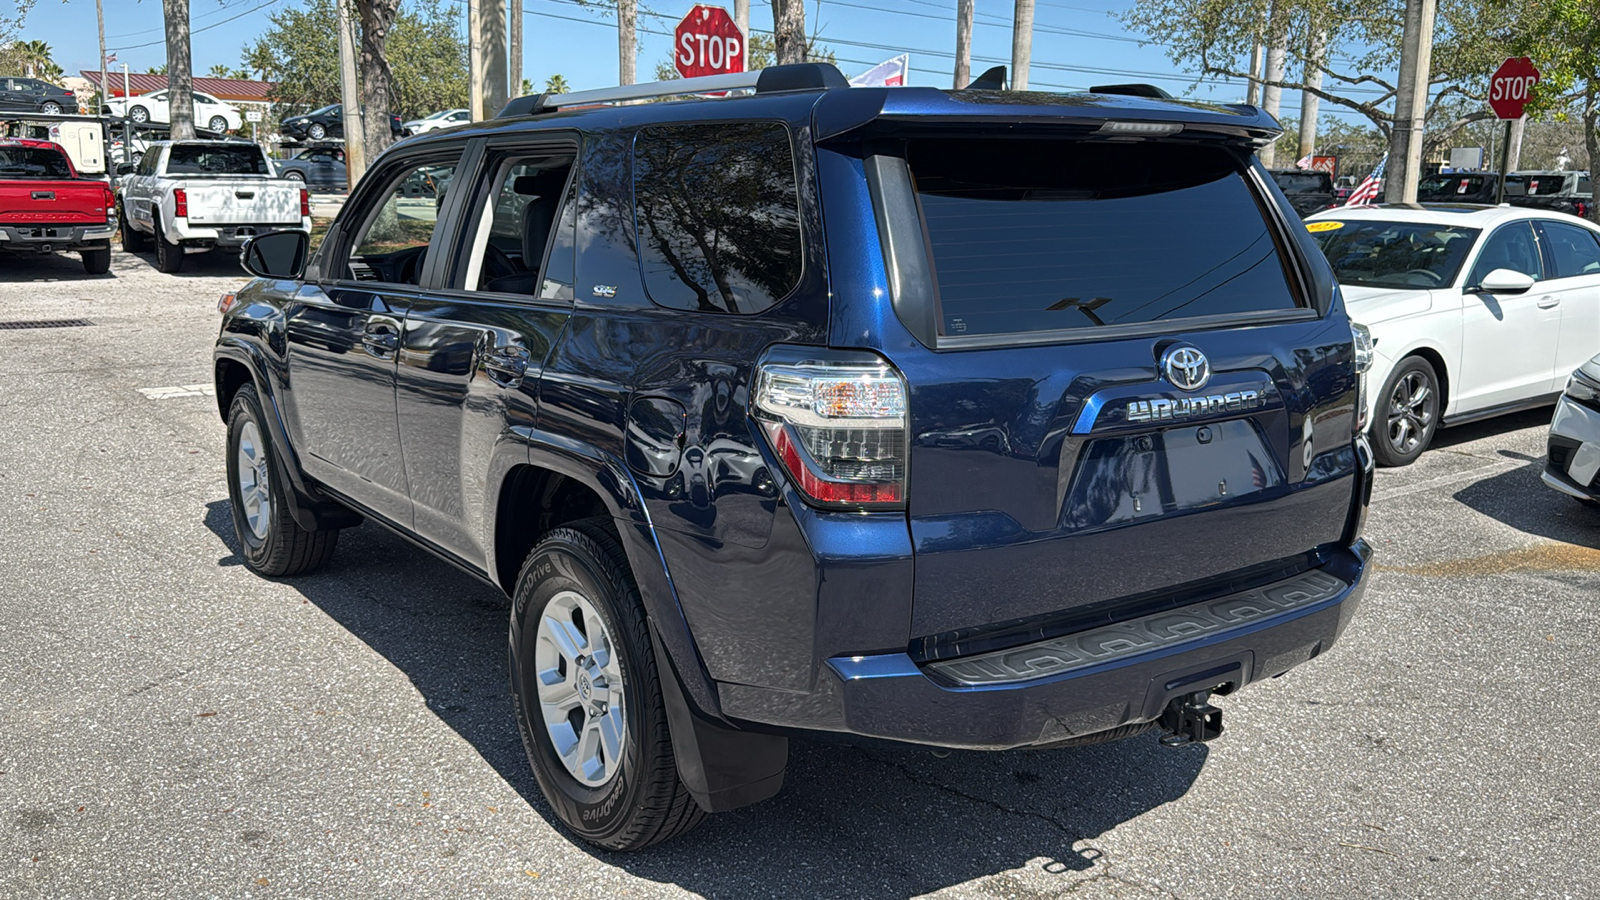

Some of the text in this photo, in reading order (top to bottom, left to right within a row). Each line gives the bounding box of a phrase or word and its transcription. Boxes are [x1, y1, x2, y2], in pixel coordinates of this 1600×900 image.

[680, 32, 740, 69] STOP
[1492, 76, 1536, 101] STOP
[516, 562, 552, 614] GeoDrive
[582, 775, 625, 823] GeoDrive
